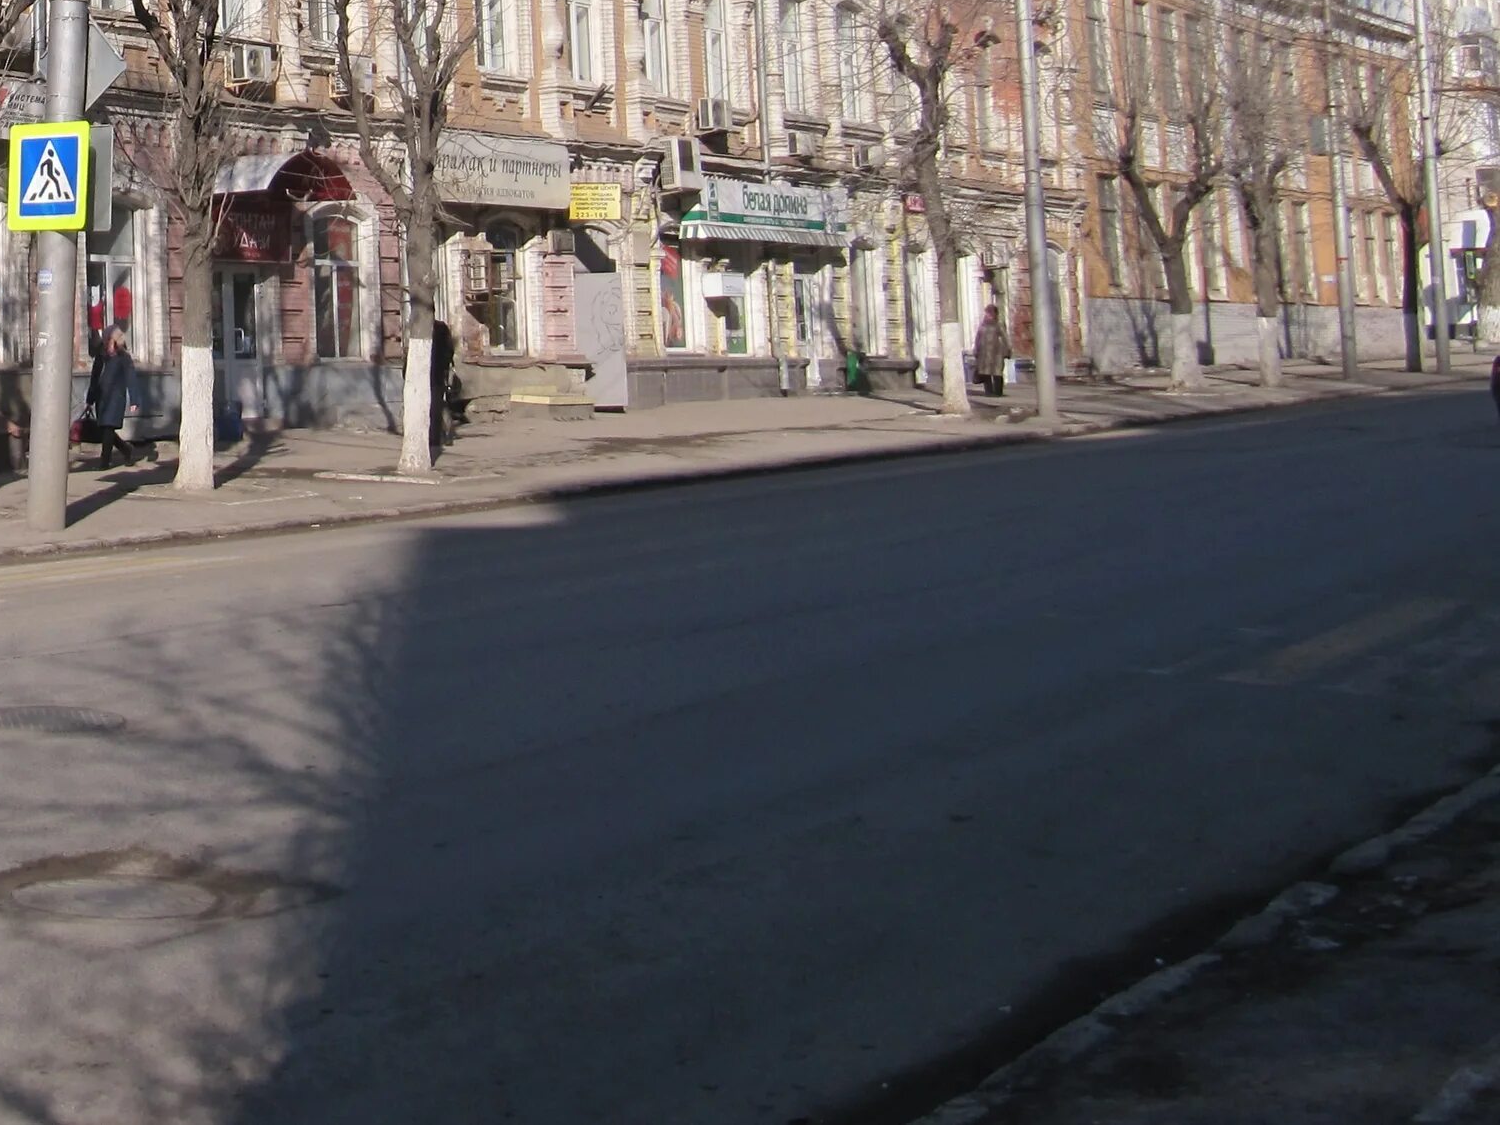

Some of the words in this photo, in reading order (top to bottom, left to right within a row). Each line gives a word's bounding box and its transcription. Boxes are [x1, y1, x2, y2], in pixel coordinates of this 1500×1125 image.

[501, 158, 561, 184] партнеры
[742, 184, 771, 212] белая
[773, 192, 808, 216] долина
